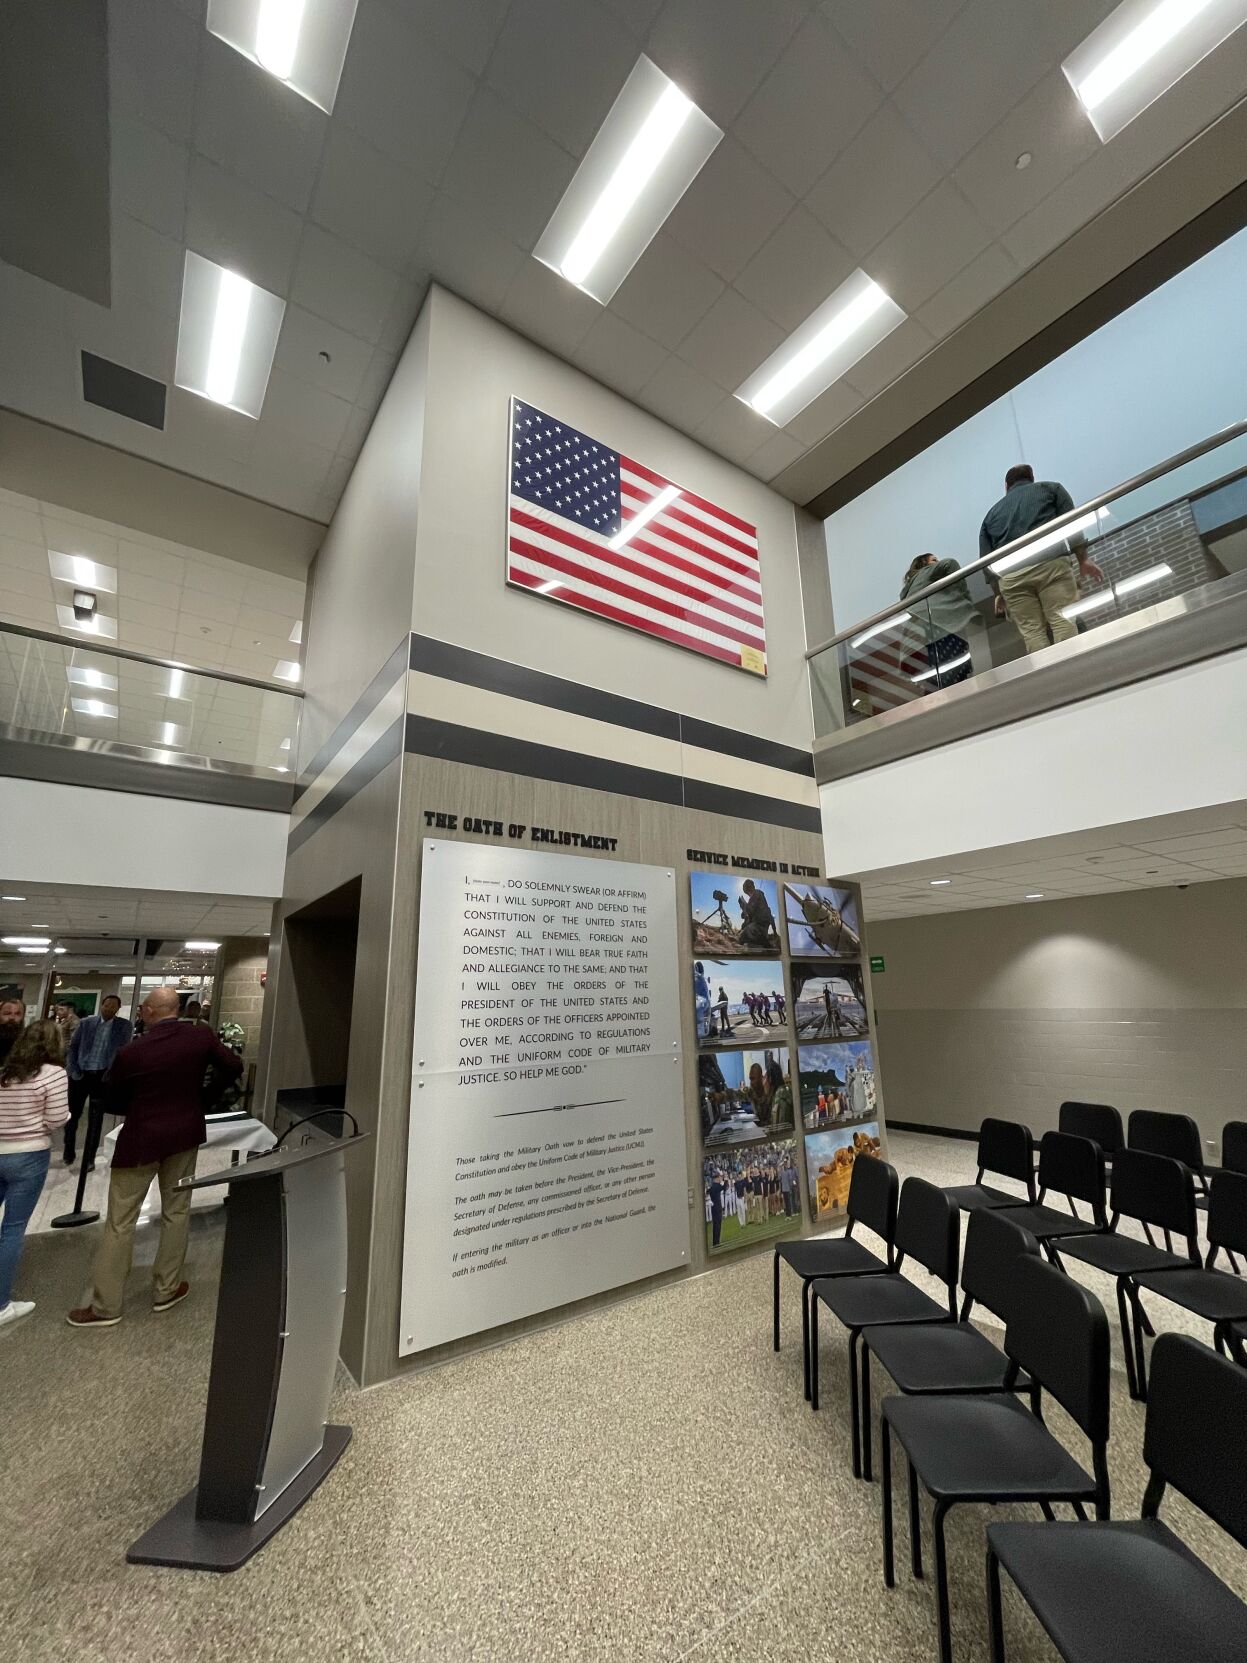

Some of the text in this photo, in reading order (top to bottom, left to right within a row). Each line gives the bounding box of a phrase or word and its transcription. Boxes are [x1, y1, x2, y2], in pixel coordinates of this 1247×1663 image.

[424, 811, 618, 851] THE OATH OF ENLISTMENT
[508, 880, 522, 888] DO
[525, 881, 571, 892] SOLEMNLY
[573, 886, 600, 895] SWEAR
[602, 888, 616, 897] (OR
[617, 890, 646, 900] AFFIRM)
[464, 893, 491, 903] THAT
[505, 896, 527, 905] WILL
[531, 898, 571, 908] SUPPORT
[576, 901, 593, 910] AND
[598, 903, 628, 912] DEFEND
[632, 906, 647, 914] THE
[464, 910, 647, 928] CONSTITUTION OF THE UNITED STATES
[463, 928, 506, 937] AGAINST
[516, 930, 532, 939] ALL
[590, 933, 623, 942] FOREIGN
[521, 947, 545, 956] THAT
[555, 948, 576, 957] WILL
[580, 949, 600, 957] BEAR
[603, 950, 623, 958] TRUE
[627, 950, 648, 958] FAITH
[462, 964, 485, 972] AND
[488, 964, 545, 973] ALLEGIANCE
[548, 965, 560, 973] TO
[563, 965, 580, 973] THE
[609, 965, 626, 974] AND
[628, 965, 648, 973] THAT
[477, 982, 500, 990] WILL
[512, 982, 536, 990] OBEY
[547, 981, 564, 990] THE
[574, 981, 606, 989] ORDERS
[615, 981, 626, 989] OF
[634, 981, 648, 989] THE
[462, 996, 649, 1009] PRESIDENT OF THE UNITED STATES AND
[461, 1012, 650, 1028] THE ORDERS OF THE OFFICERS APPOINTED
[460, 1037, 487, 1047] OVER
[519, 1032, 574, 1044] ACCORDING
[579, 1031, 591, 1040] TO
[597, 1028, 650, 1039] REGULATIONS
[459, 1044, 650, 1067] AND THE UNIFORM CODE OF MILITARY
[504, 1071, 517, 1081] SO
[520, 1068, 543, 1079] HELP
[546, 1067, 559, 1077] ME
[456, 1158, 475, 1166] Those
[480, 1153, 500, 1162] taking
[504, 1150, 514, 1158] the
[518, 1147, 541, 1155] Military
[545, 1142, 559, 1152] Oath
[587, 1136, 604, 1144] defend
[455, 1168, 496, 1181] Constitution
[498, 1164, 510, 1174] and
[511, 1163, 526, 1171] obey
[539, 1157, 563, 1166] Uniform
[563, 1153, 578, 1161] Code
[579, 1150, 585, 1159] of
[587, 1149, 606, 1157] Military
[455, 1197, 467, 1205] The
[470, 1192, 485, 1202] oath
[515, 1185, 532, 1193] taken
[534, 1180, 554, 1189] before
[454, 1208, 486, 1221] Secretary
[488, 1205, 496, 1214] of
[528, 1197, 539, 1205] any
[541, 1187, 582, 1203] commissioned
[453, 1221, 490, 1237] designated
[492, 1218, 511, 1228] under
[511, 1209, 546, 1224] regulations
[547, 1202, 577, 1216] prescribed
[578, 1200, 585, 1208] by
[586, 1199, 595, 1207] the
[596, 1193, 621, 1204] Secretary
[461, 1247, 489, 1260] entering
[492, 1243, 503, 1252] the
[505, 1237, 530, 1248] military
[551, 1227, 571, 1237] officer
[571, 1224, 579, 1232] or
[581, 1221, 592, 1229] into
[452, 1266, 468, 1278] oath
[470, 1265, 476, 1274] is
